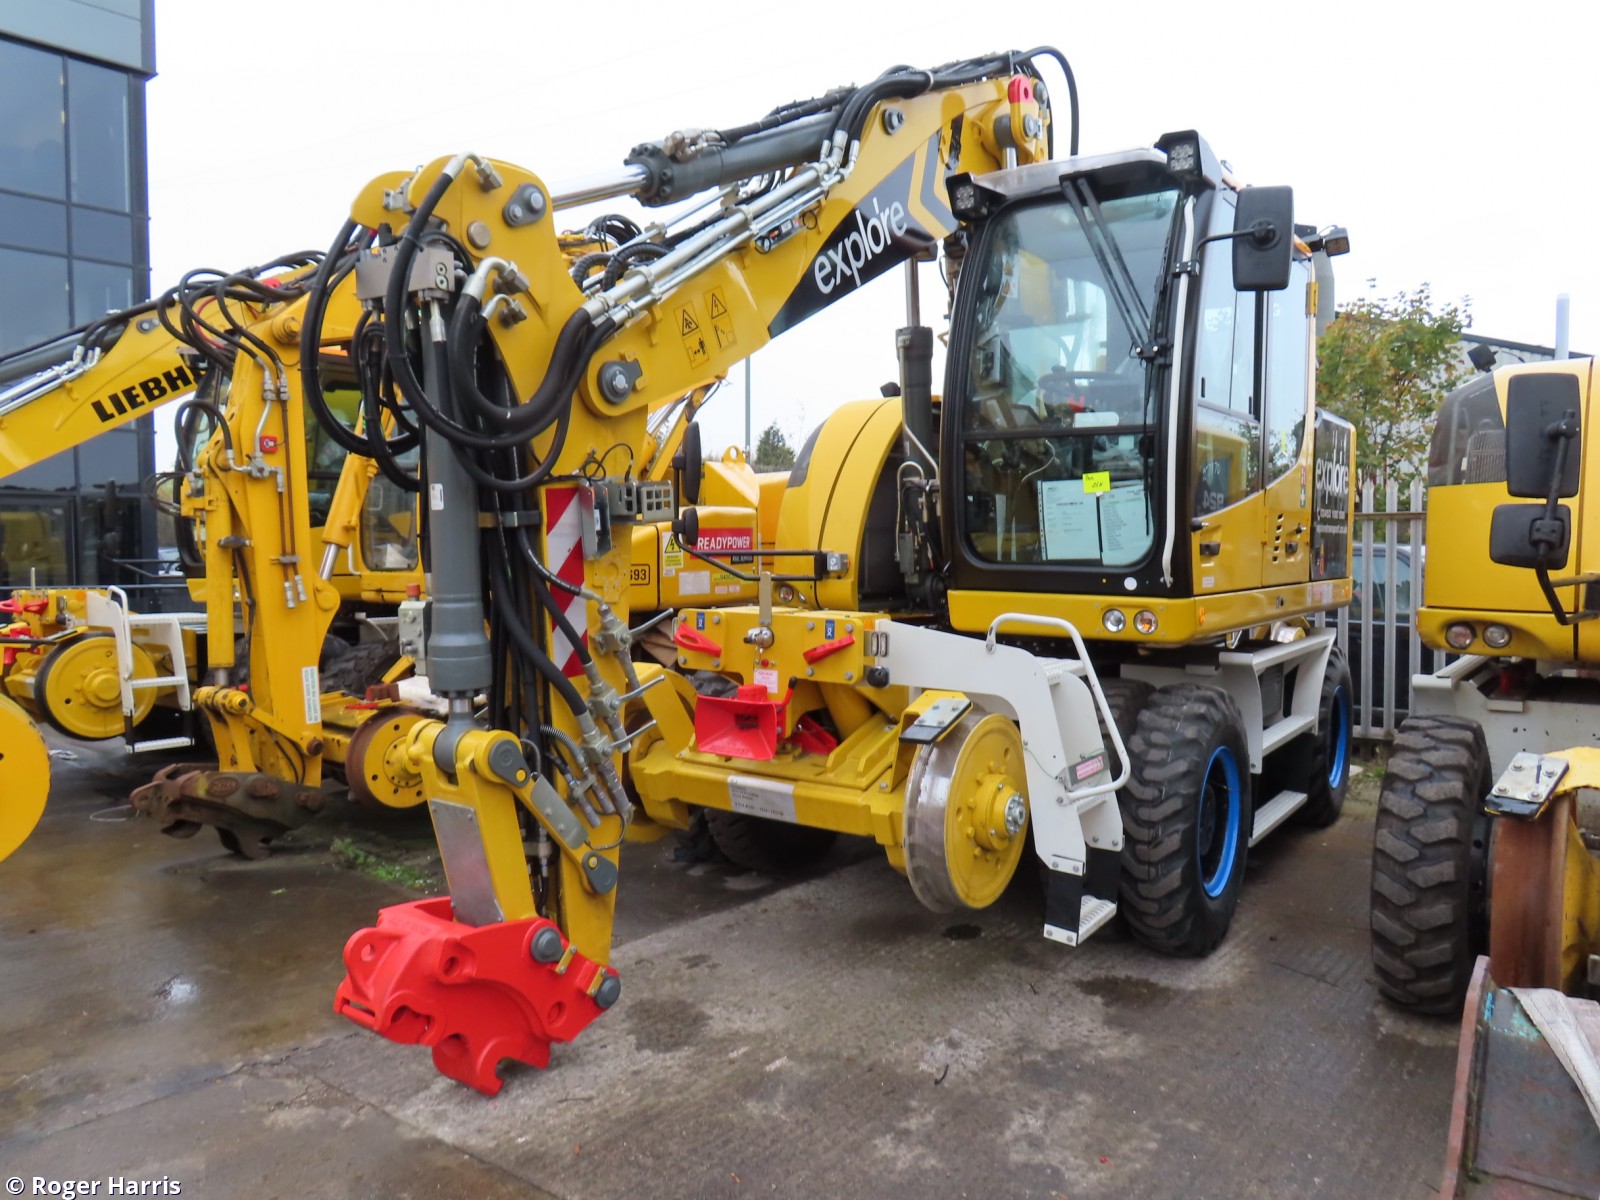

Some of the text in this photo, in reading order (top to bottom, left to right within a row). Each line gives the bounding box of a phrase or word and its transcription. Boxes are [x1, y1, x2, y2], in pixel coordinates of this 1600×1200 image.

[814, 197, 908, 294] explore
[91, 365, 196, 423] LIEBH
[1316, 449, 1349, 503] explore
[697, 536, 751, 550] READYPOWER
